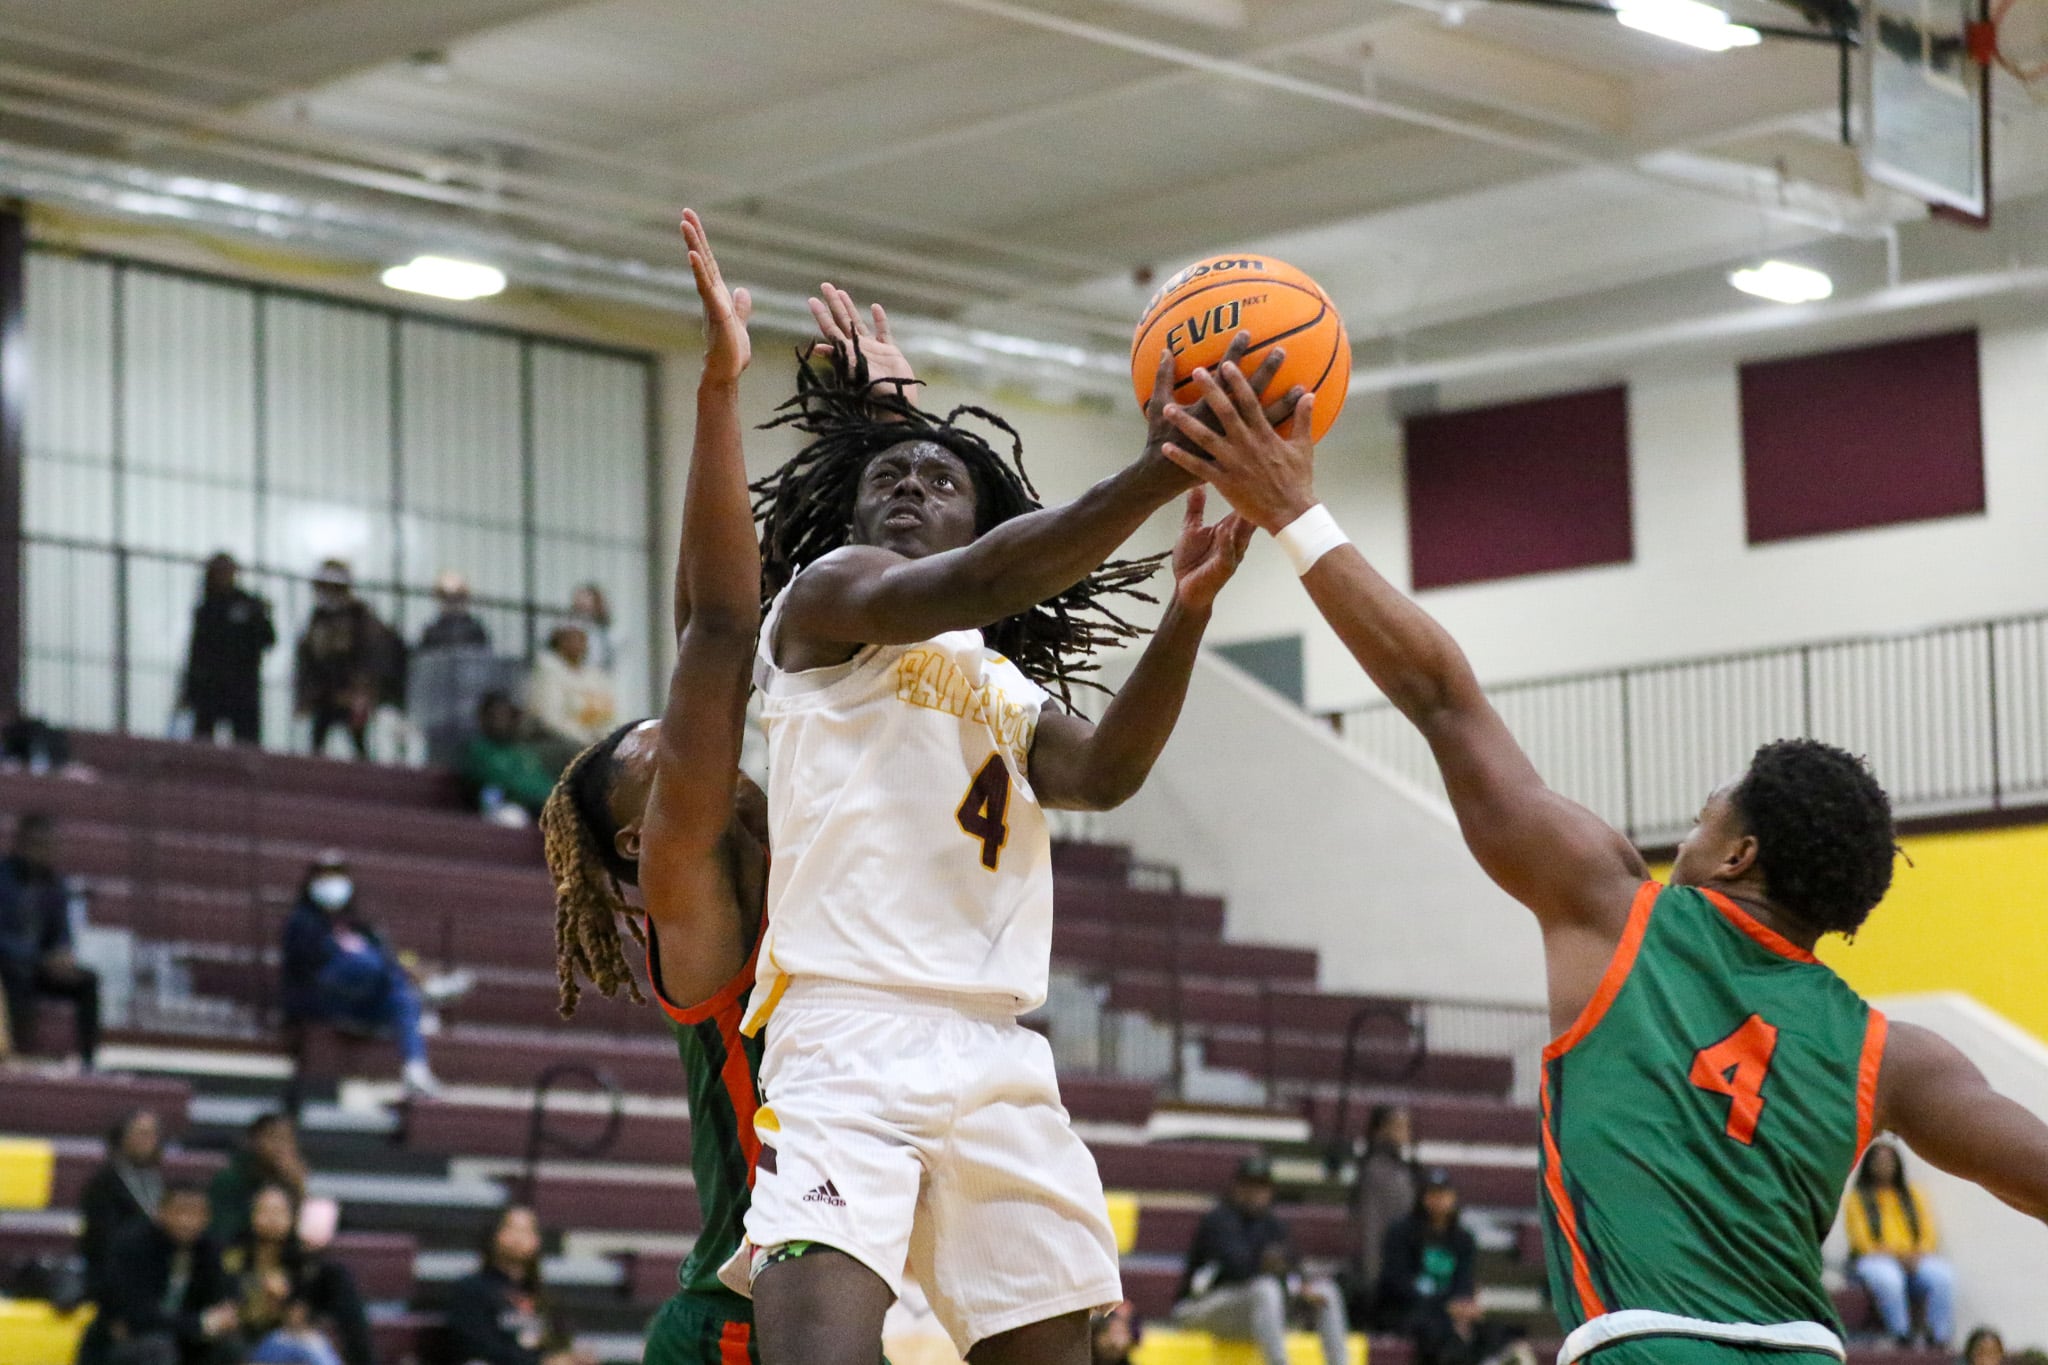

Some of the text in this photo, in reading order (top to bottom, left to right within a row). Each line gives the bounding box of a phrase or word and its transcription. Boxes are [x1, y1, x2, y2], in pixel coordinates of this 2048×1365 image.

[1165, 299, 1241, 358] EVO
[954, 750, 1012, 873] 4
[1687, 1012, 1778, 1147] 4
[803, 1193, 846, 1207] adidas
